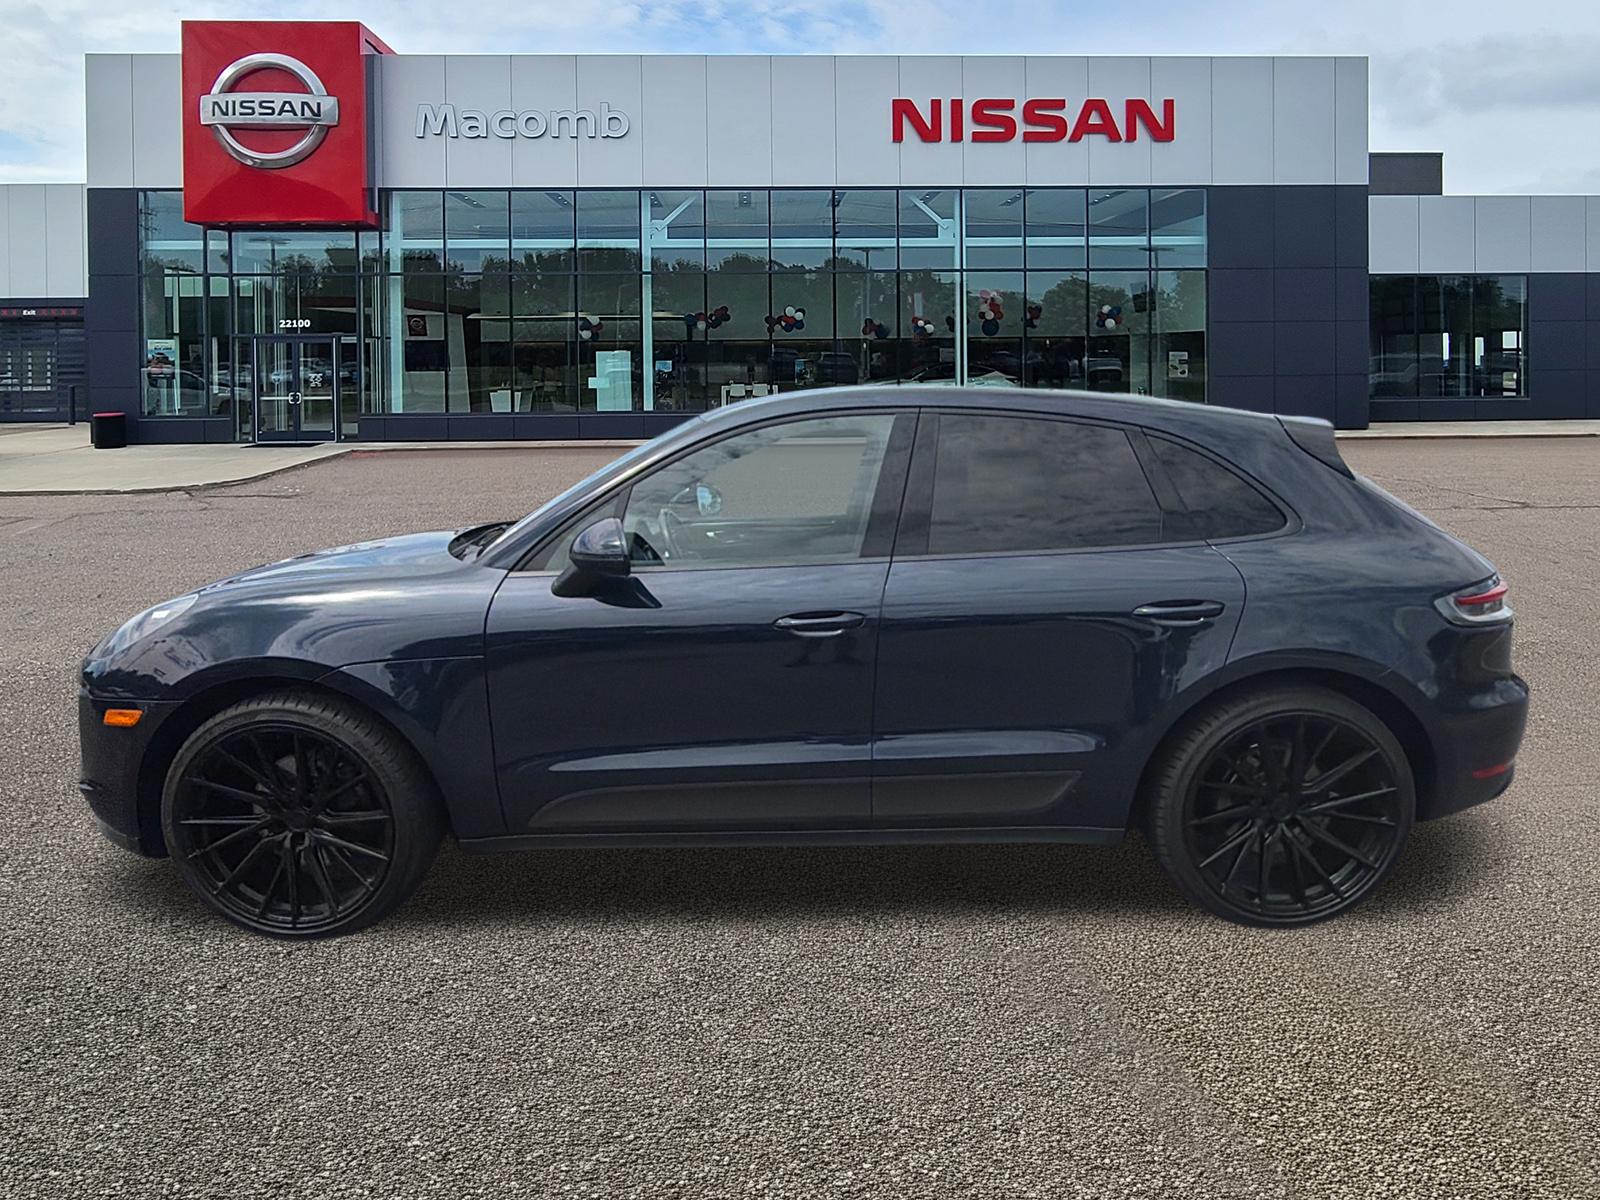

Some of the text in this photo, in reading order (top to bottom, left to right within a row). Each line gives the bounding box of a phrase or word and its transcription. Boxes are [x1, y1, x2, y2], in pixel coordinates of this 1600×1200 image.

[212, 100, 322, 117] NISSAN
[415, 101, 630, 139] Macomb
[892, 98, 1175, 143] NISSAN
[279, 319, 311, 328] 22100
